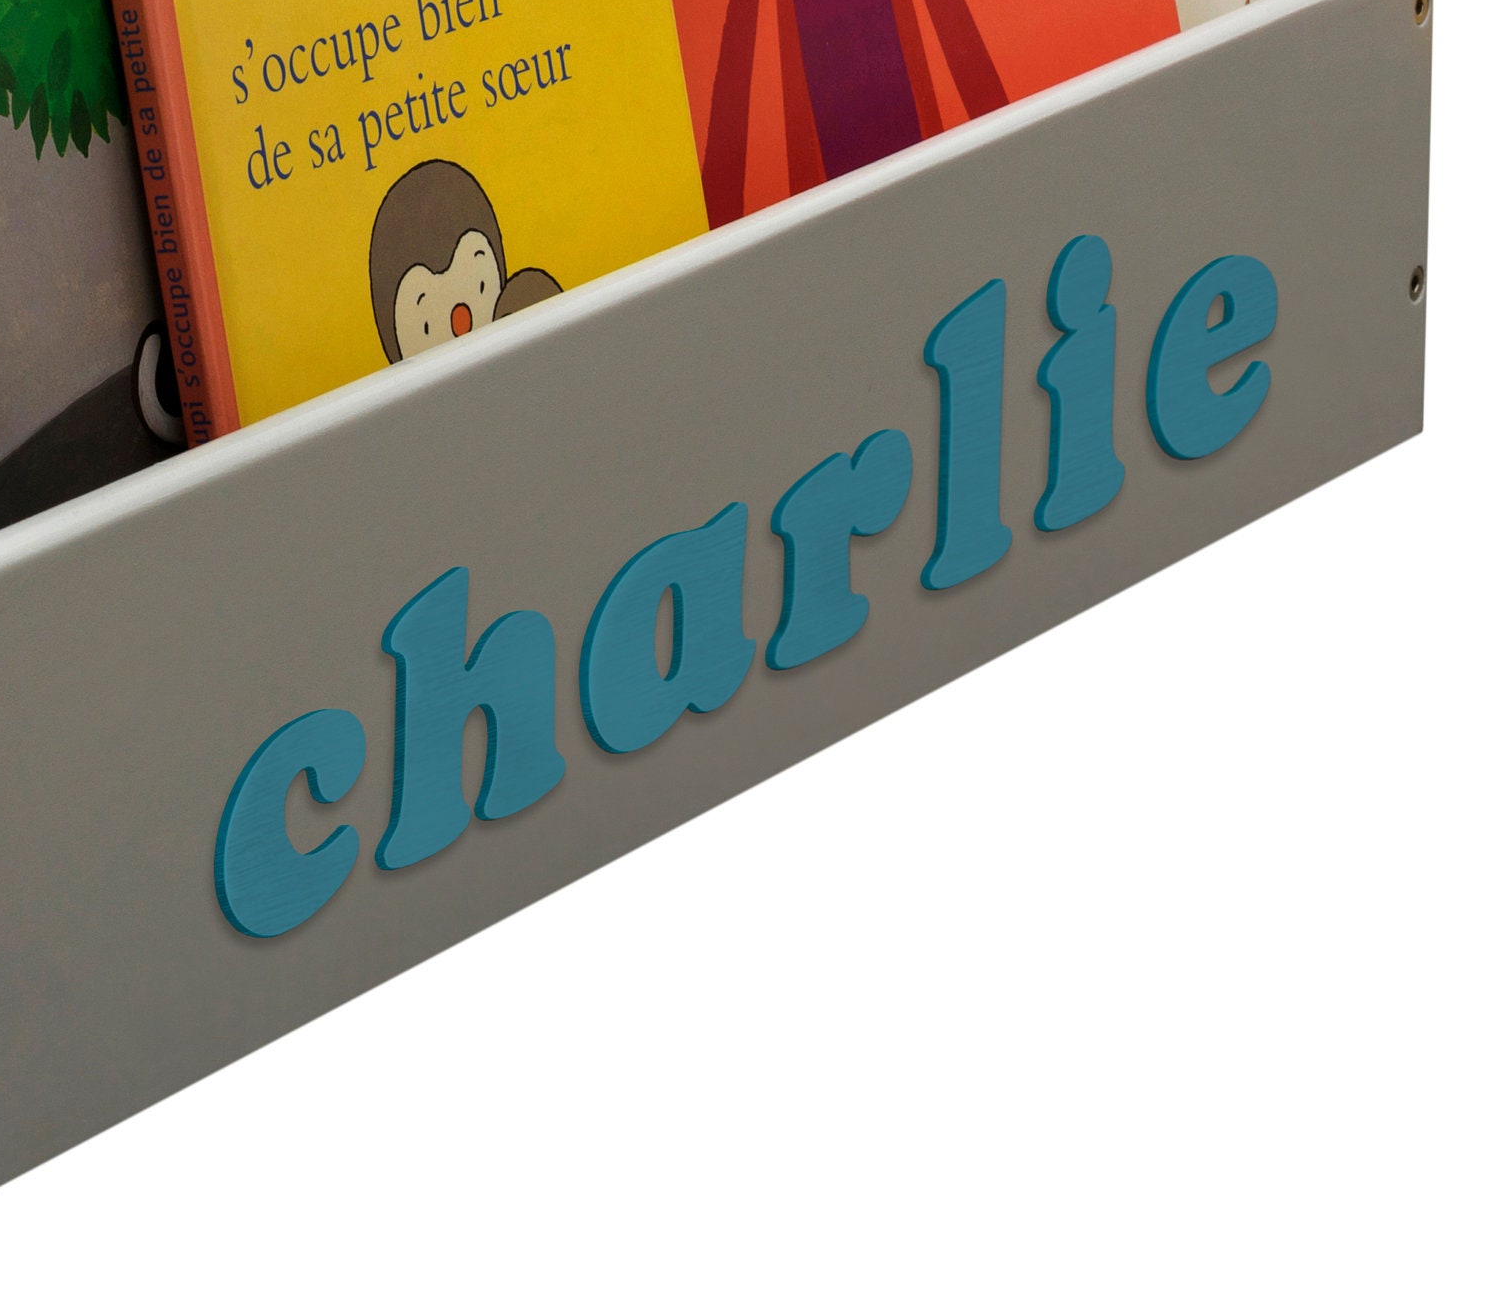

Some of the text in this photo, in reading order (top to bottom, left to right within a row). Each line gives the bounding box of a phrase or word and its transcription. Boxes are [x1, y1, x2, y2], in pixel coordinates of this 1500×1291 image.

[120, 9, 156, 92] petite
[232, 12, 403, 106] s'occupe
[138, 106, 158, 135] sa
[246, 43, 573, 190] de sa petite sœur
[143, 148, 166, 181] de
[154, 194, 178, 254] bien
[166, 267, 200, 388] s'occupe
[213, 234, 1279, 937] charlie
